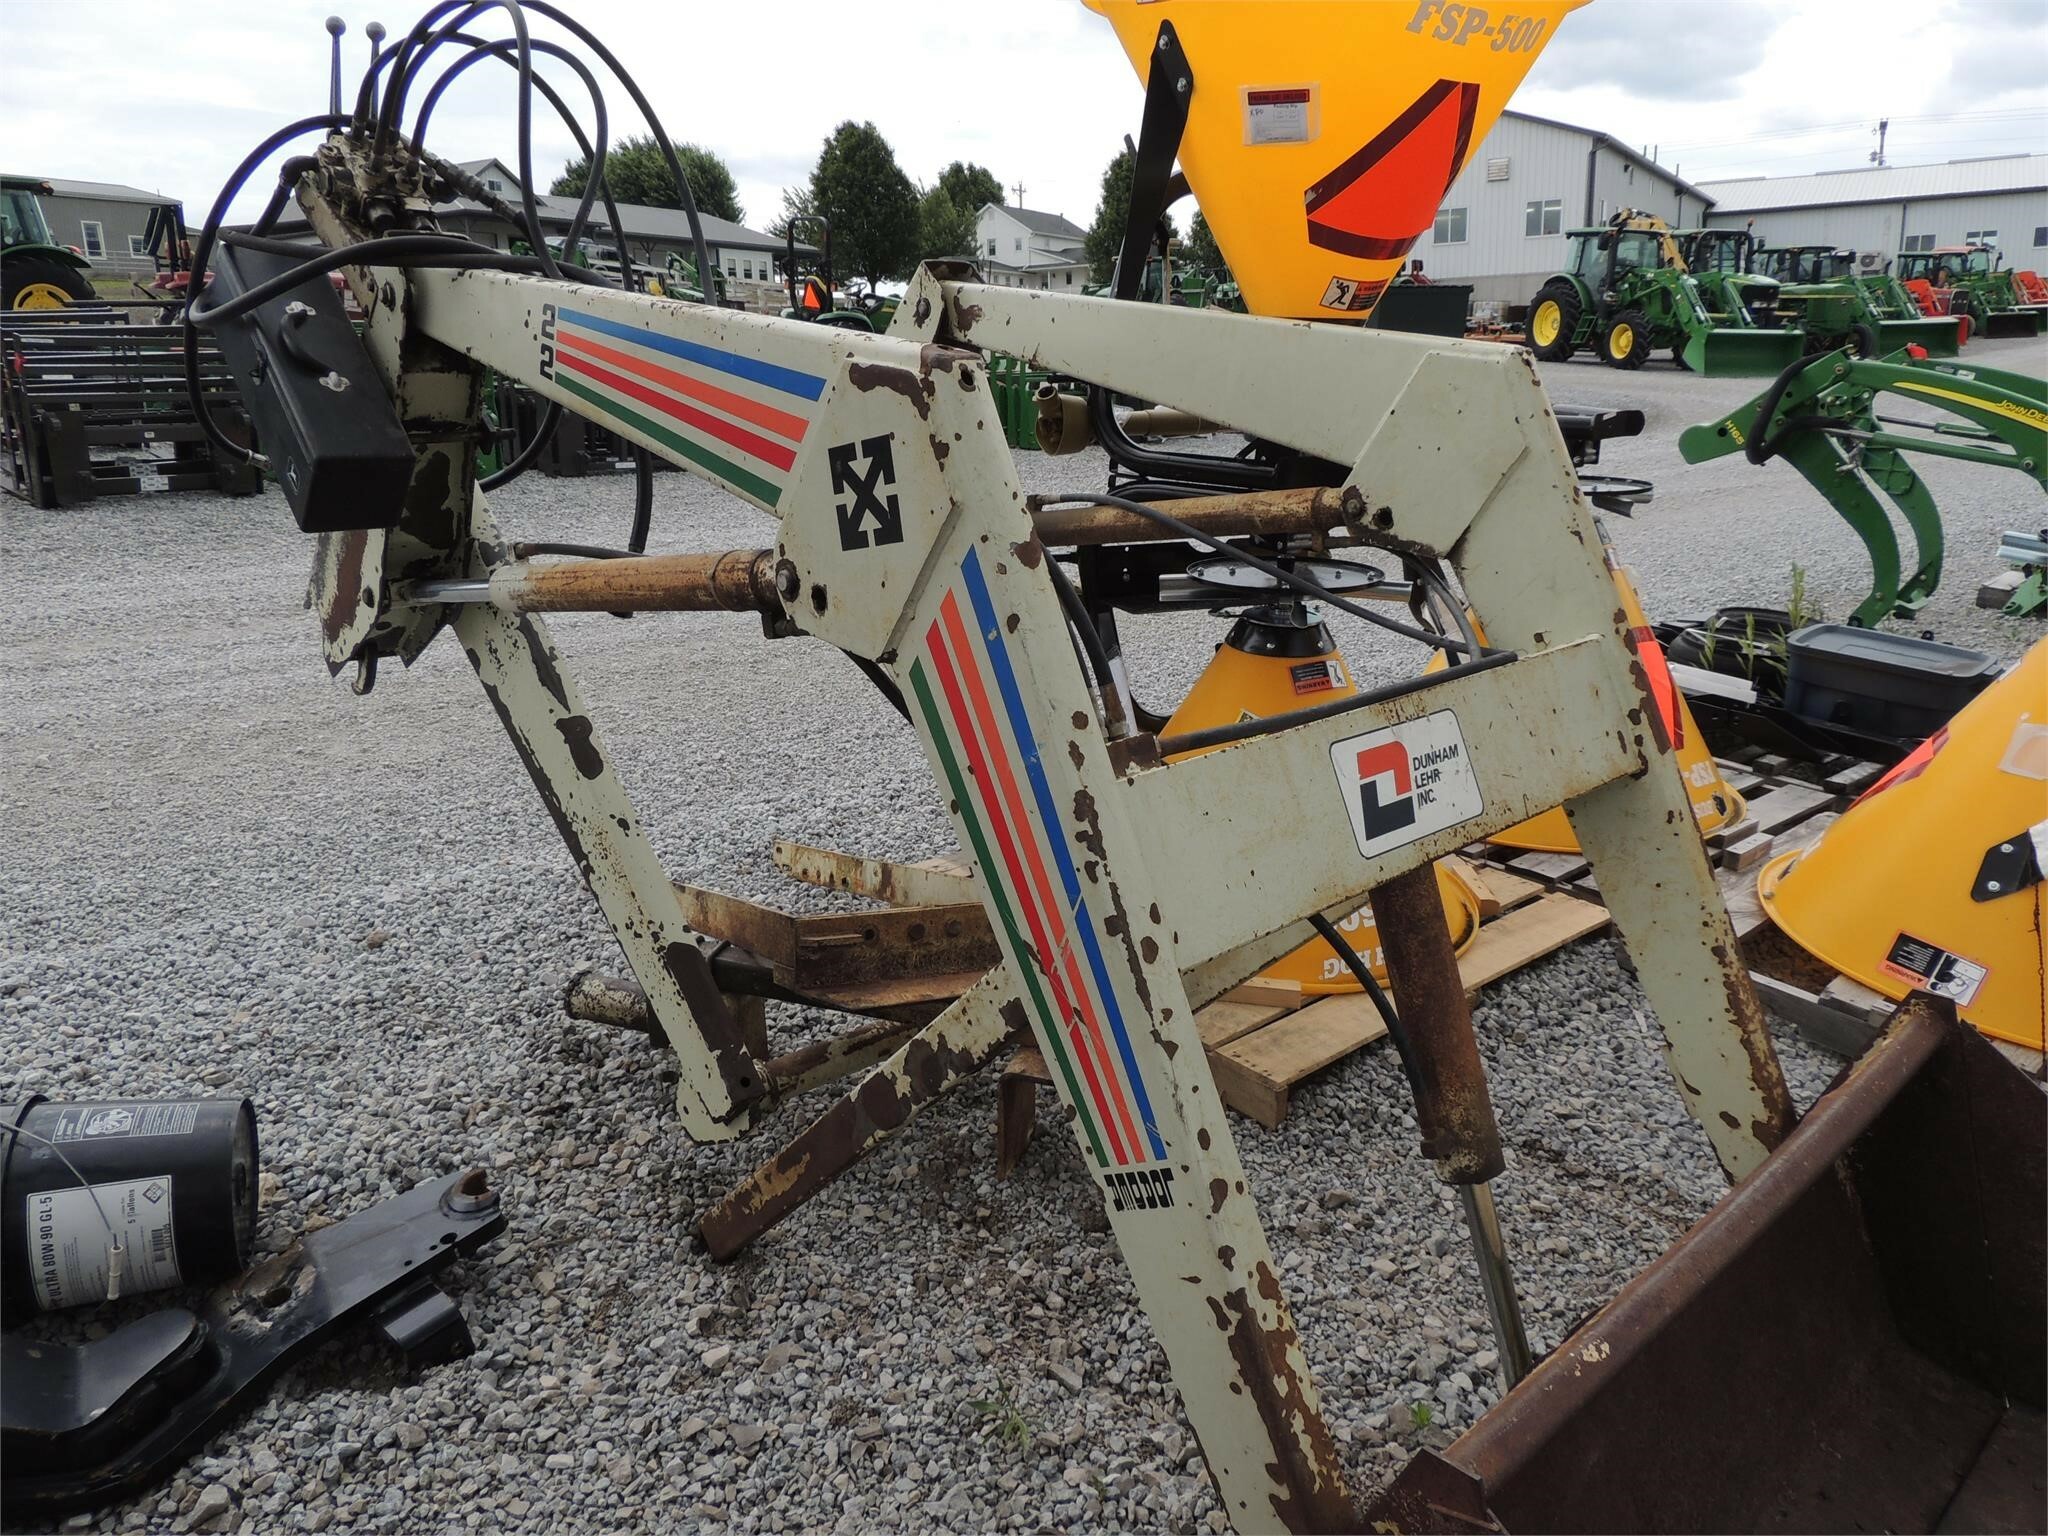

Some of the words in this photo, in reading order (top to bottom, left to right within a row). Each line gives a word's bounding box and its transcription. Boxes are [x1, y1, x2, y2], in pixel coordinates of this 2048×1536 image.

[1405, 0, 1547, 52] FSP-500
[1996, 400, 2029, 416] JOHN
[1412, 743, 1459, 771] DUNHAM
[1415, 768, 1441, 789] LEHR
[1417, 788, 1437, 809] INC.
[39, 1196, 53, 1222] GL-5
[40, 1226, 56, 1267] 80W-90
[44, 1268, 62, 1300] ULTRA
